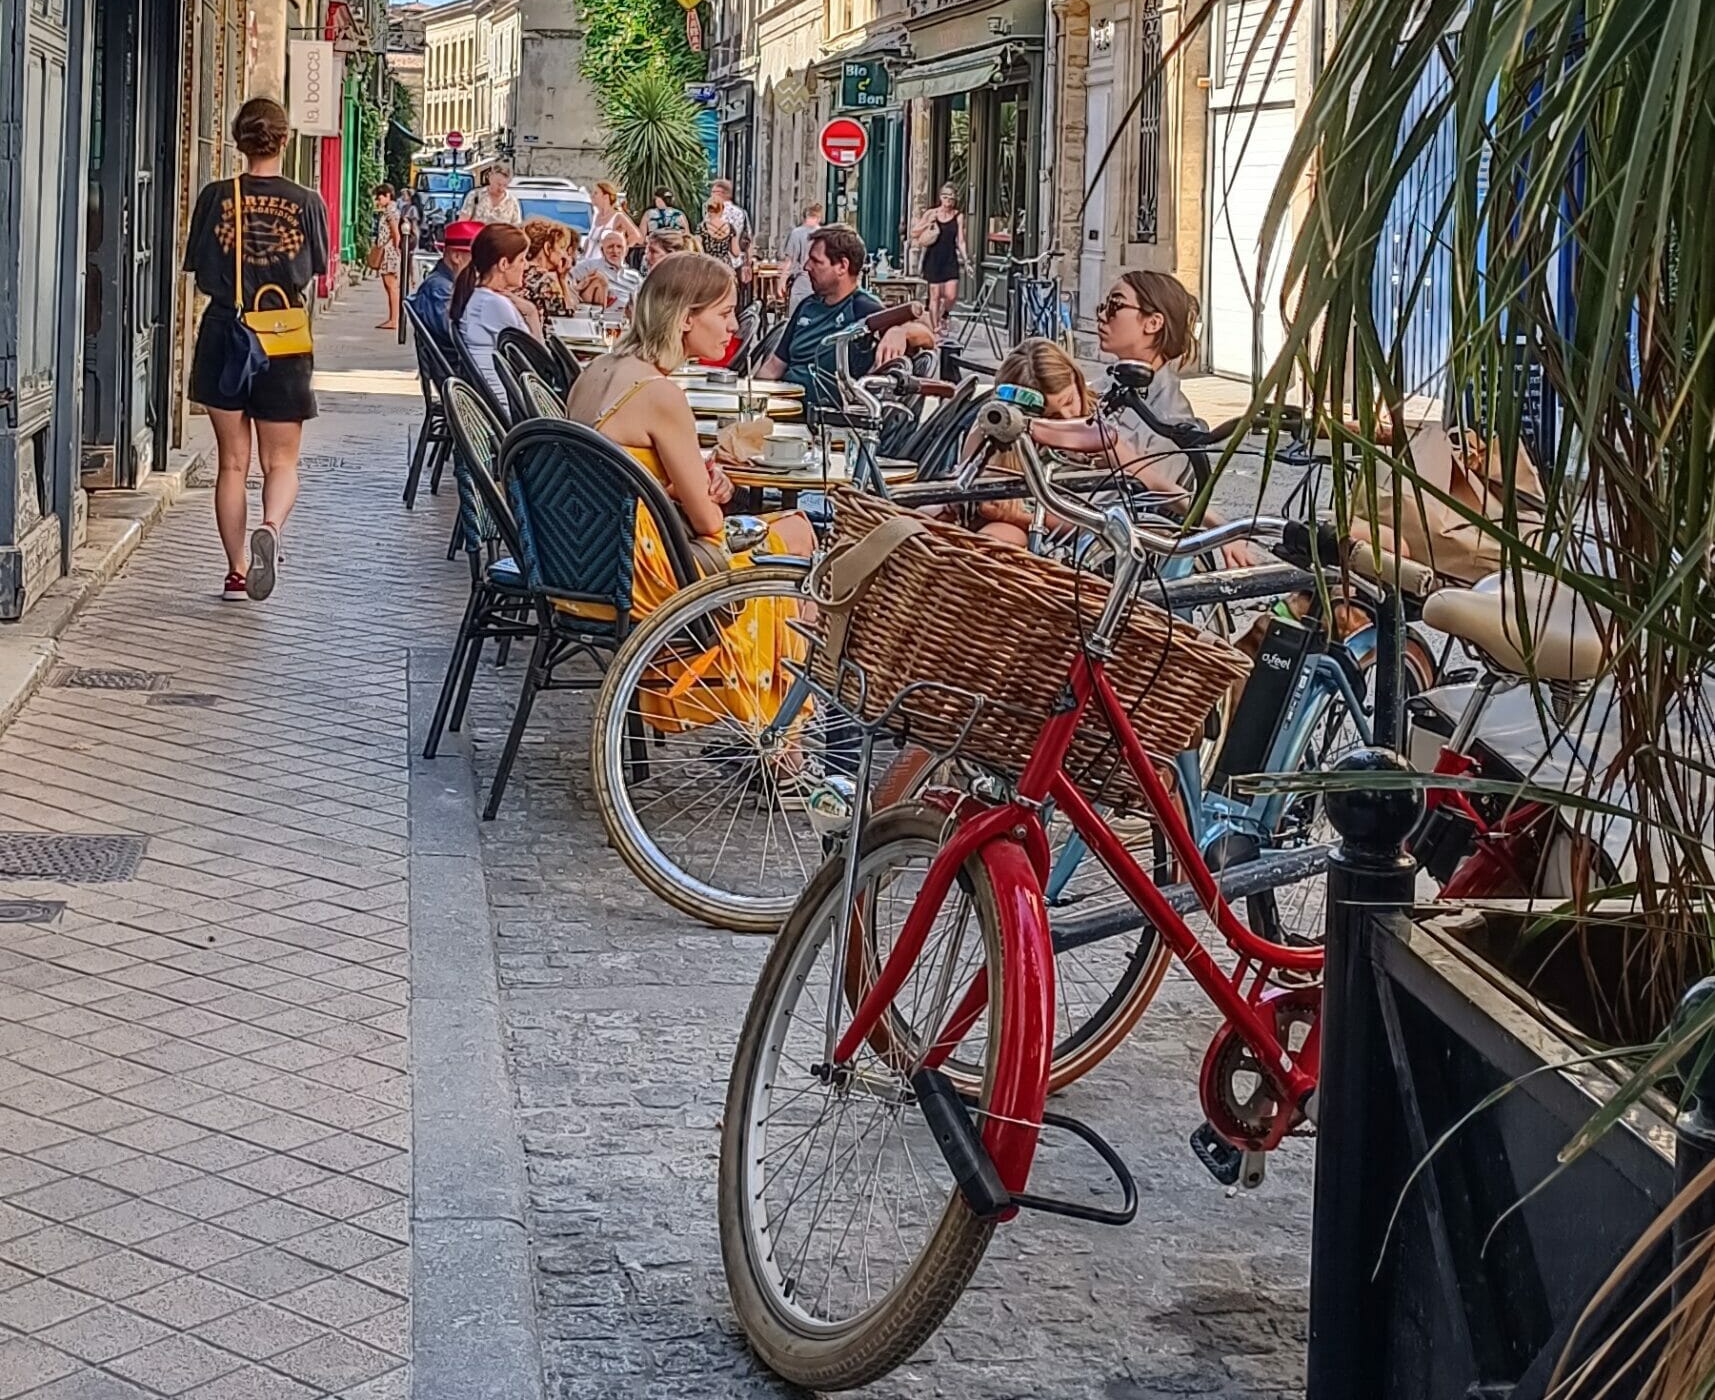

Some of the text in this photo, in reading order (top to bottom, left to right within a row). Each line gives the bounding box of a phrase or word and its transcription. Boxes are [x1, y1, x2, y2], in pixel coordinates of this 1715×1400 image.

[845, 64, 867, 77] Bio
[303, 48, 320, 124] la bocca
[858, 92, 884, 105] Bon
[222, 195, 303, 215] BRTELS'
